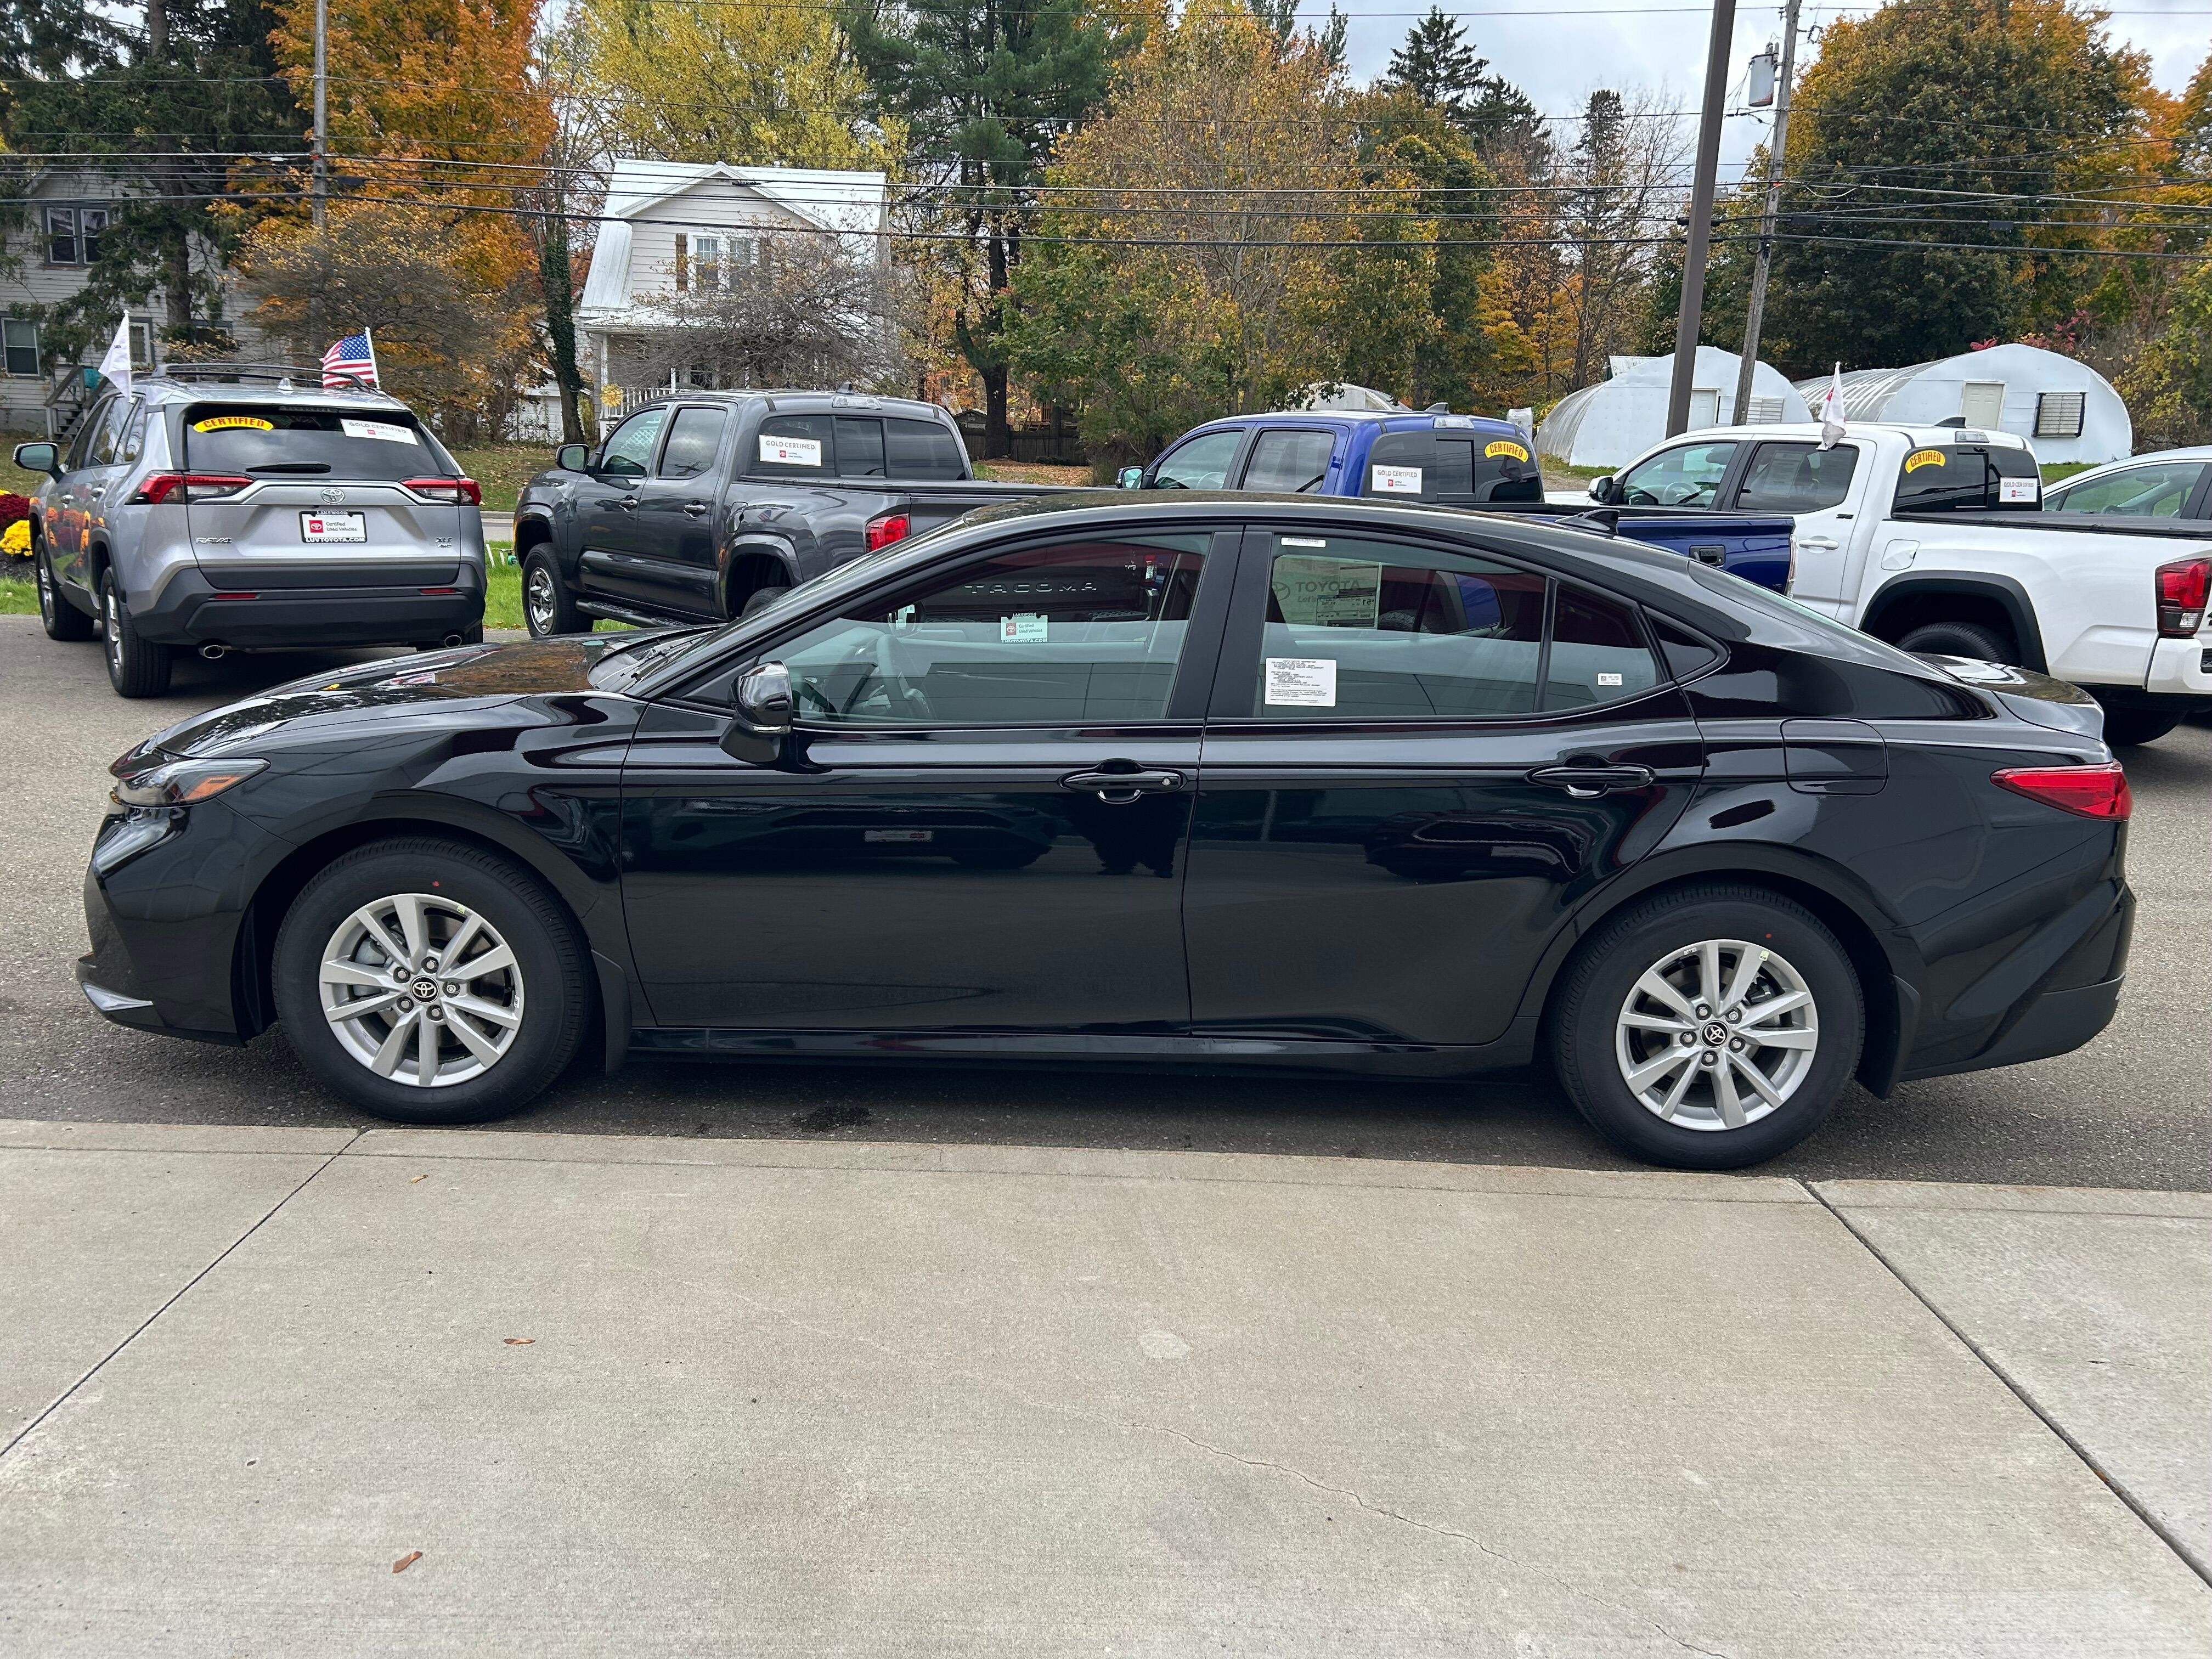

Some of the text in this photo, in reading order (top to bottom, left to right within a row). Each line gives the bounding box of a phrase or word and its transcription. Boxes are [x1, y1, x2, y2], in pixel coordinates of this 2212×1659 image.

[203, 417, 264, 428] CERTIFIED
[371, 424, 407, 433] CERTIFIED
[1489, 443, 1523, 458] CERTIFIED
[1910, 452, 1941, 467] CERTIFIED
[964, 582, 1097, 594] TACOMA
[1295, 580, 1360, 592] TOYOTA
